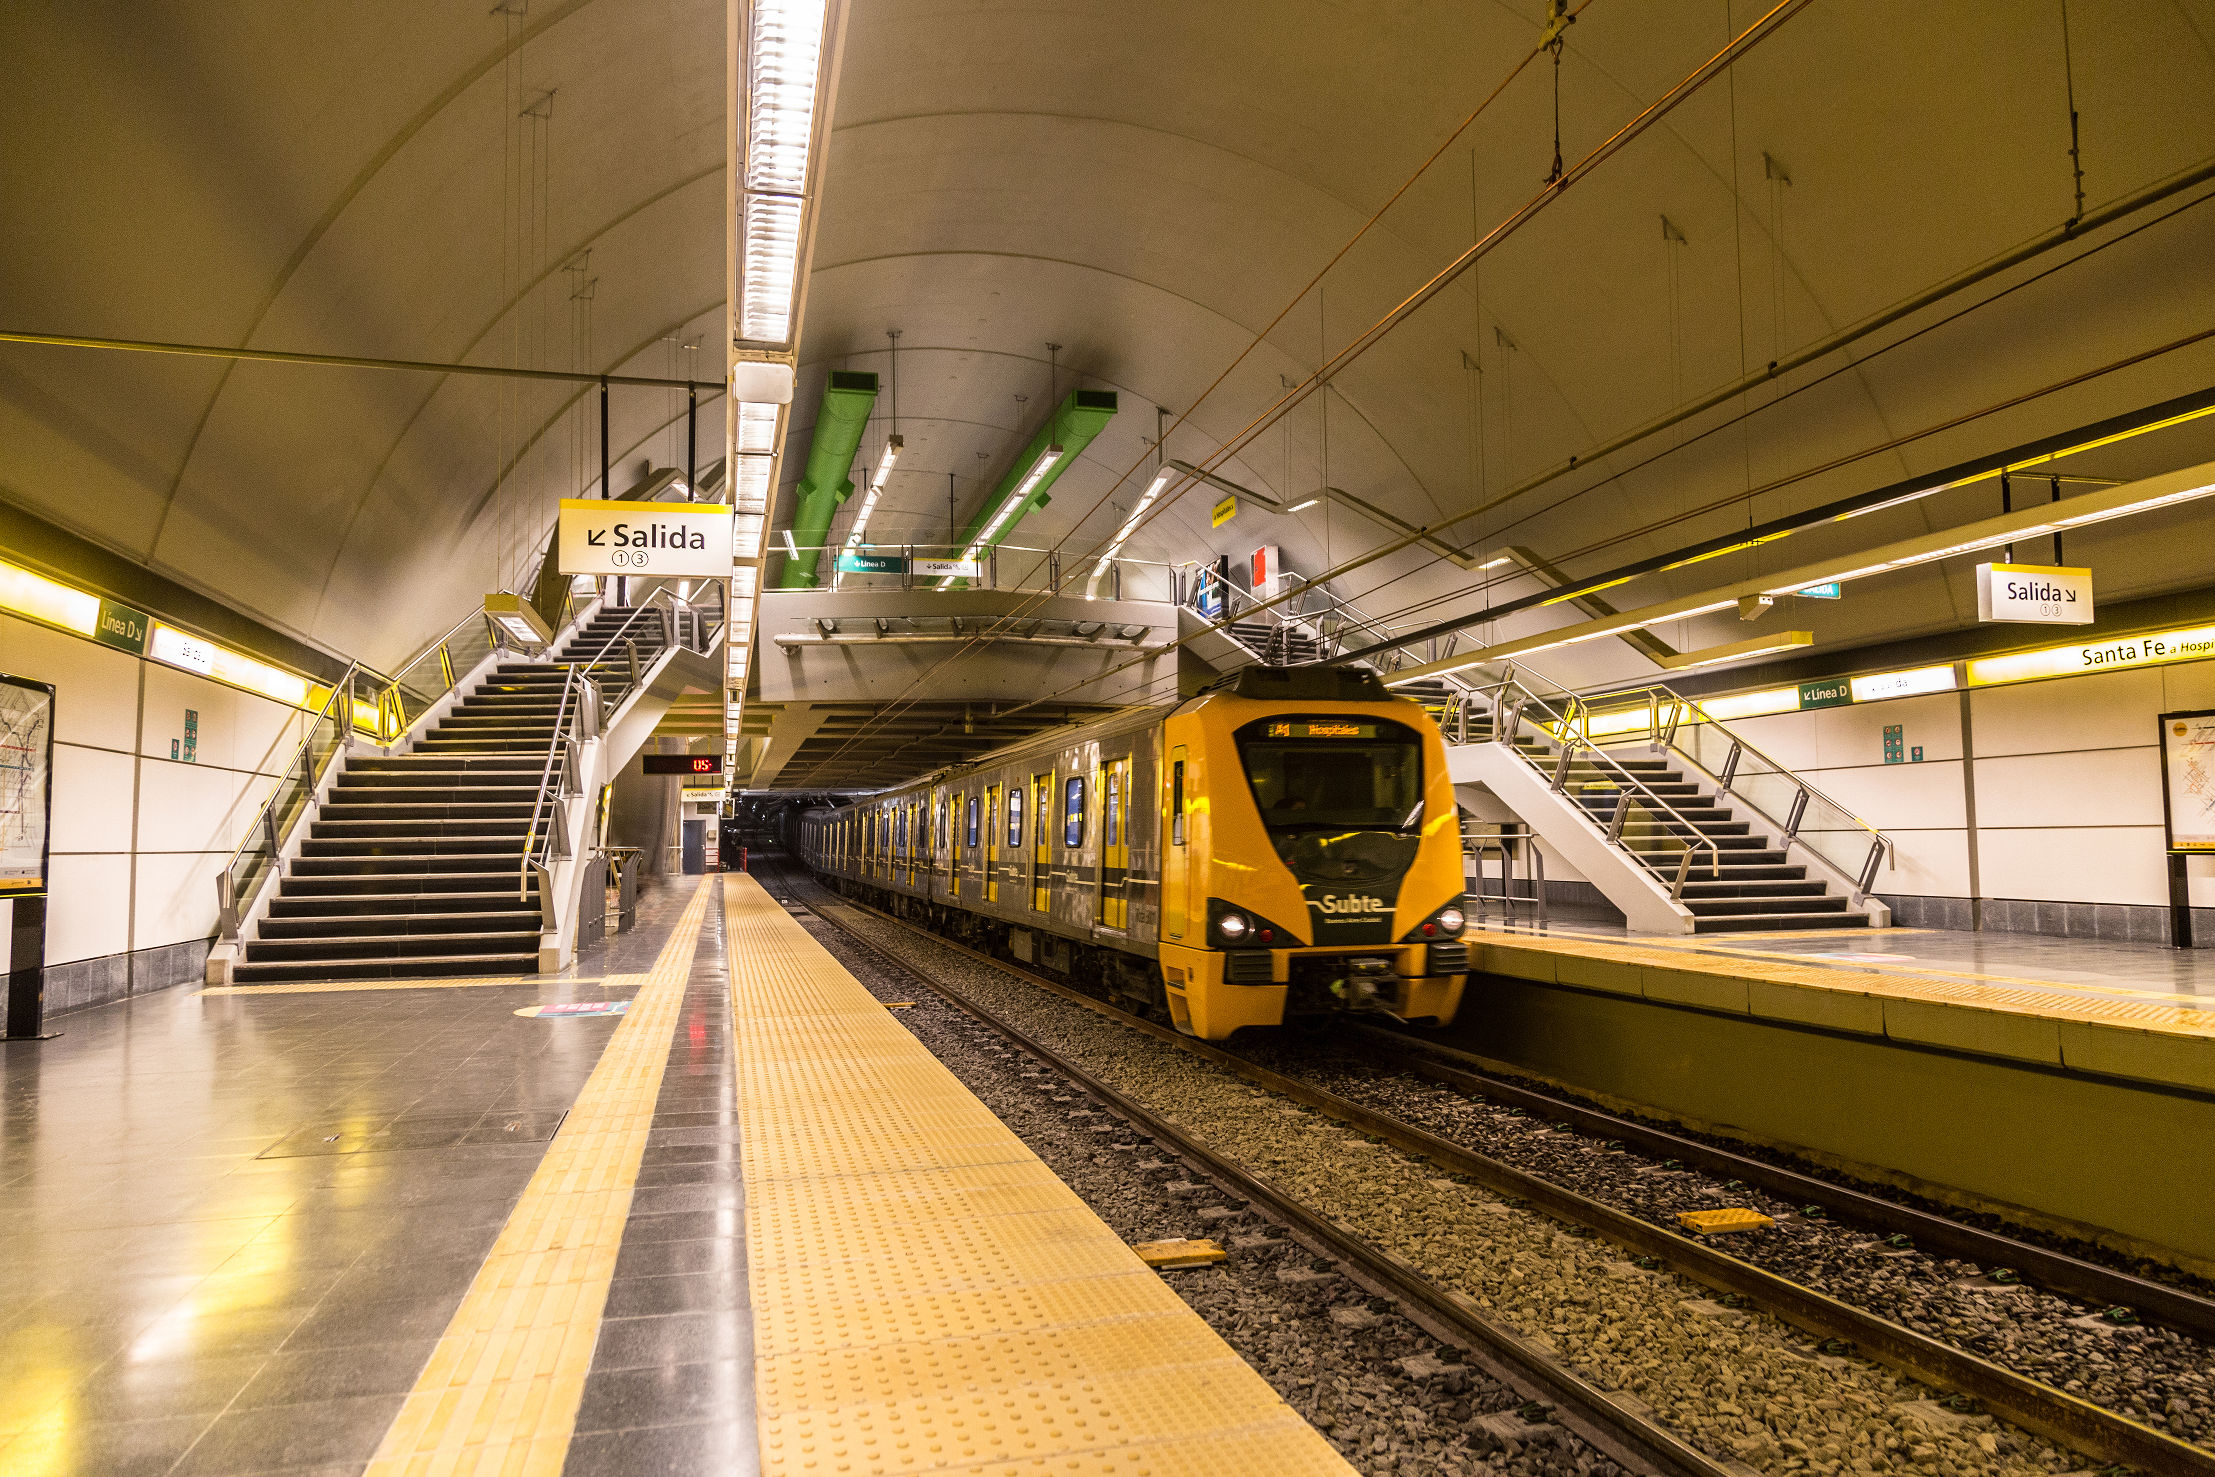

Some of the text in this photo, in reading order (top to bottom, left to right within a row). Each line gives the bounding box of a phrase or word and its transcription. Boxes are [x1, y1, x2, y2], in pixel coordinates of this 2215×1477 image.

[613, 523, 705, 550] Salida
[2008, 582, 2062, 602] Salida
[101, 610, 136, 639] Línea D
[2082, 645, 2137, 666] Santa
[2143, 639, 2166, 657] Fe
[2169, 646, 2177, 654] a
[1811, 685, 1848, 701] Línea D
[1322, 893, 1384, 914] Subte
